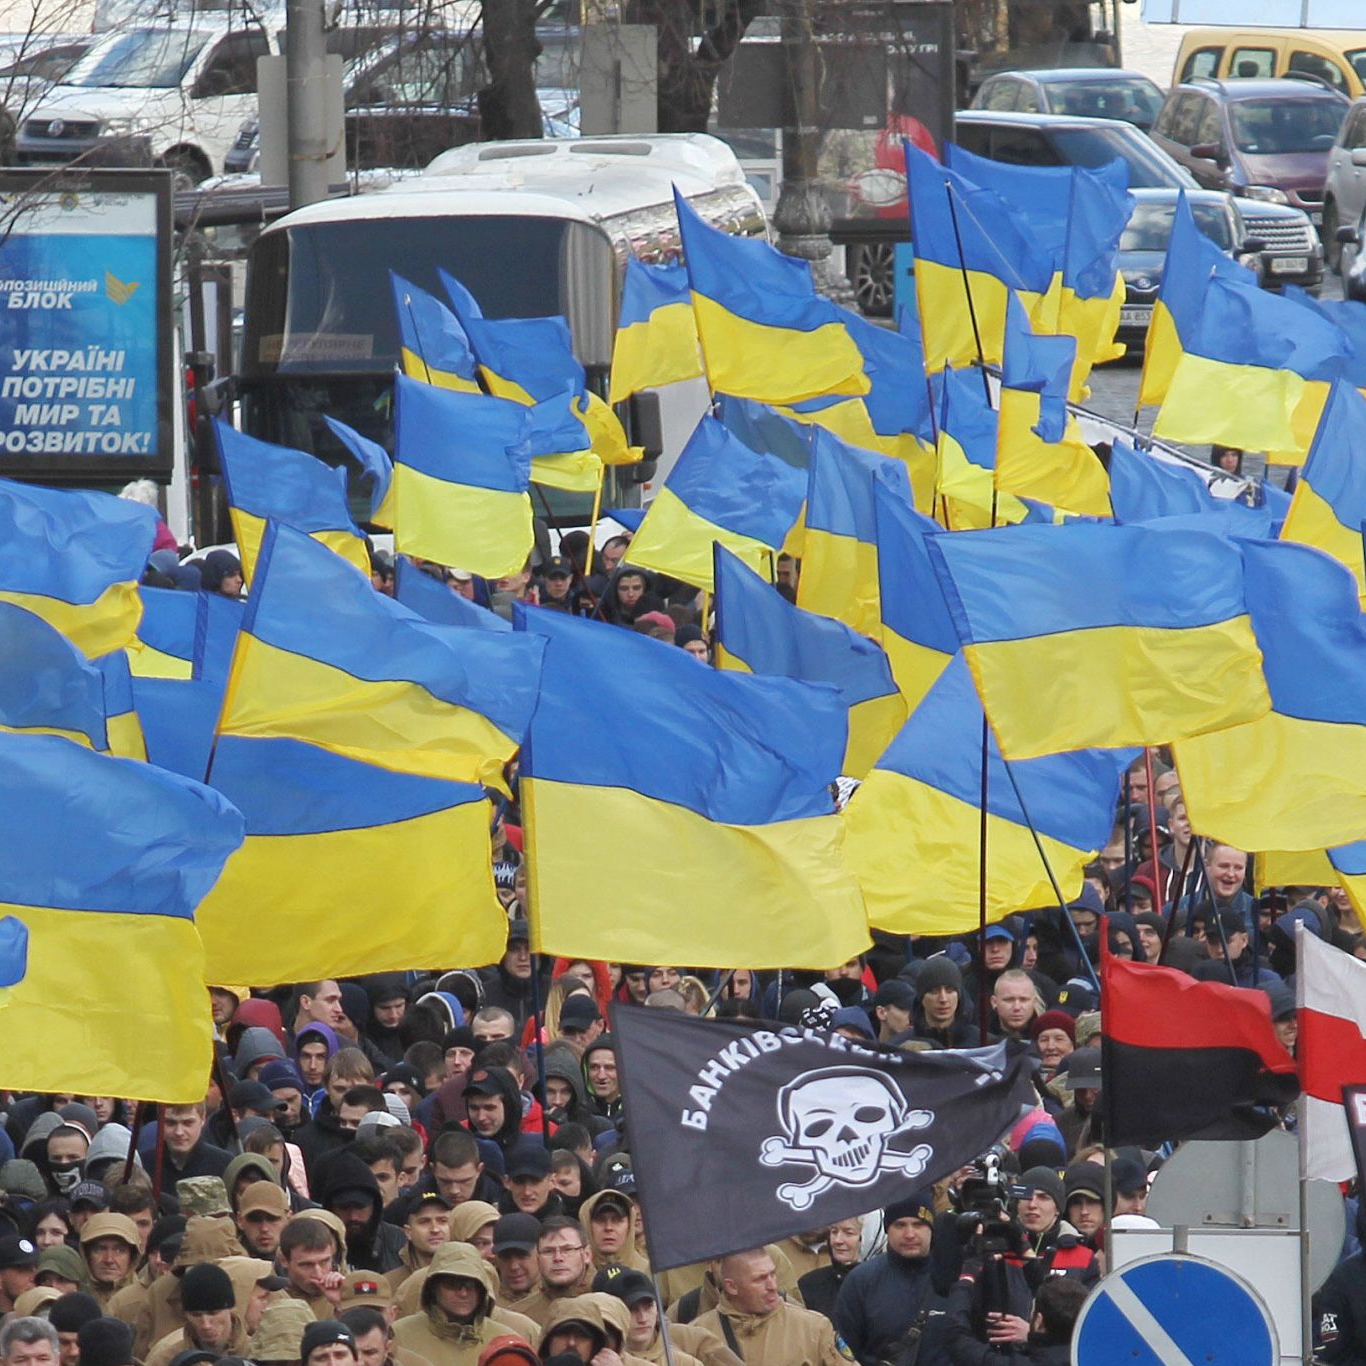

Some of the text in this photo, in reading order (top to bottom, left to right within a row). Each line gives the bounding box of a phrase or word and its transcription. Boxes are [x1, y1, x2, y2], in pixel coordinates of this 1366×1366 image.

[8, 292, 74, 309] БЛОК
[11, 345, 125, 371] УКРАЇНІ
[1, 376, 136, 398] ПОТРІБНІ
[13, 404, 121, 426] МИР ТА
